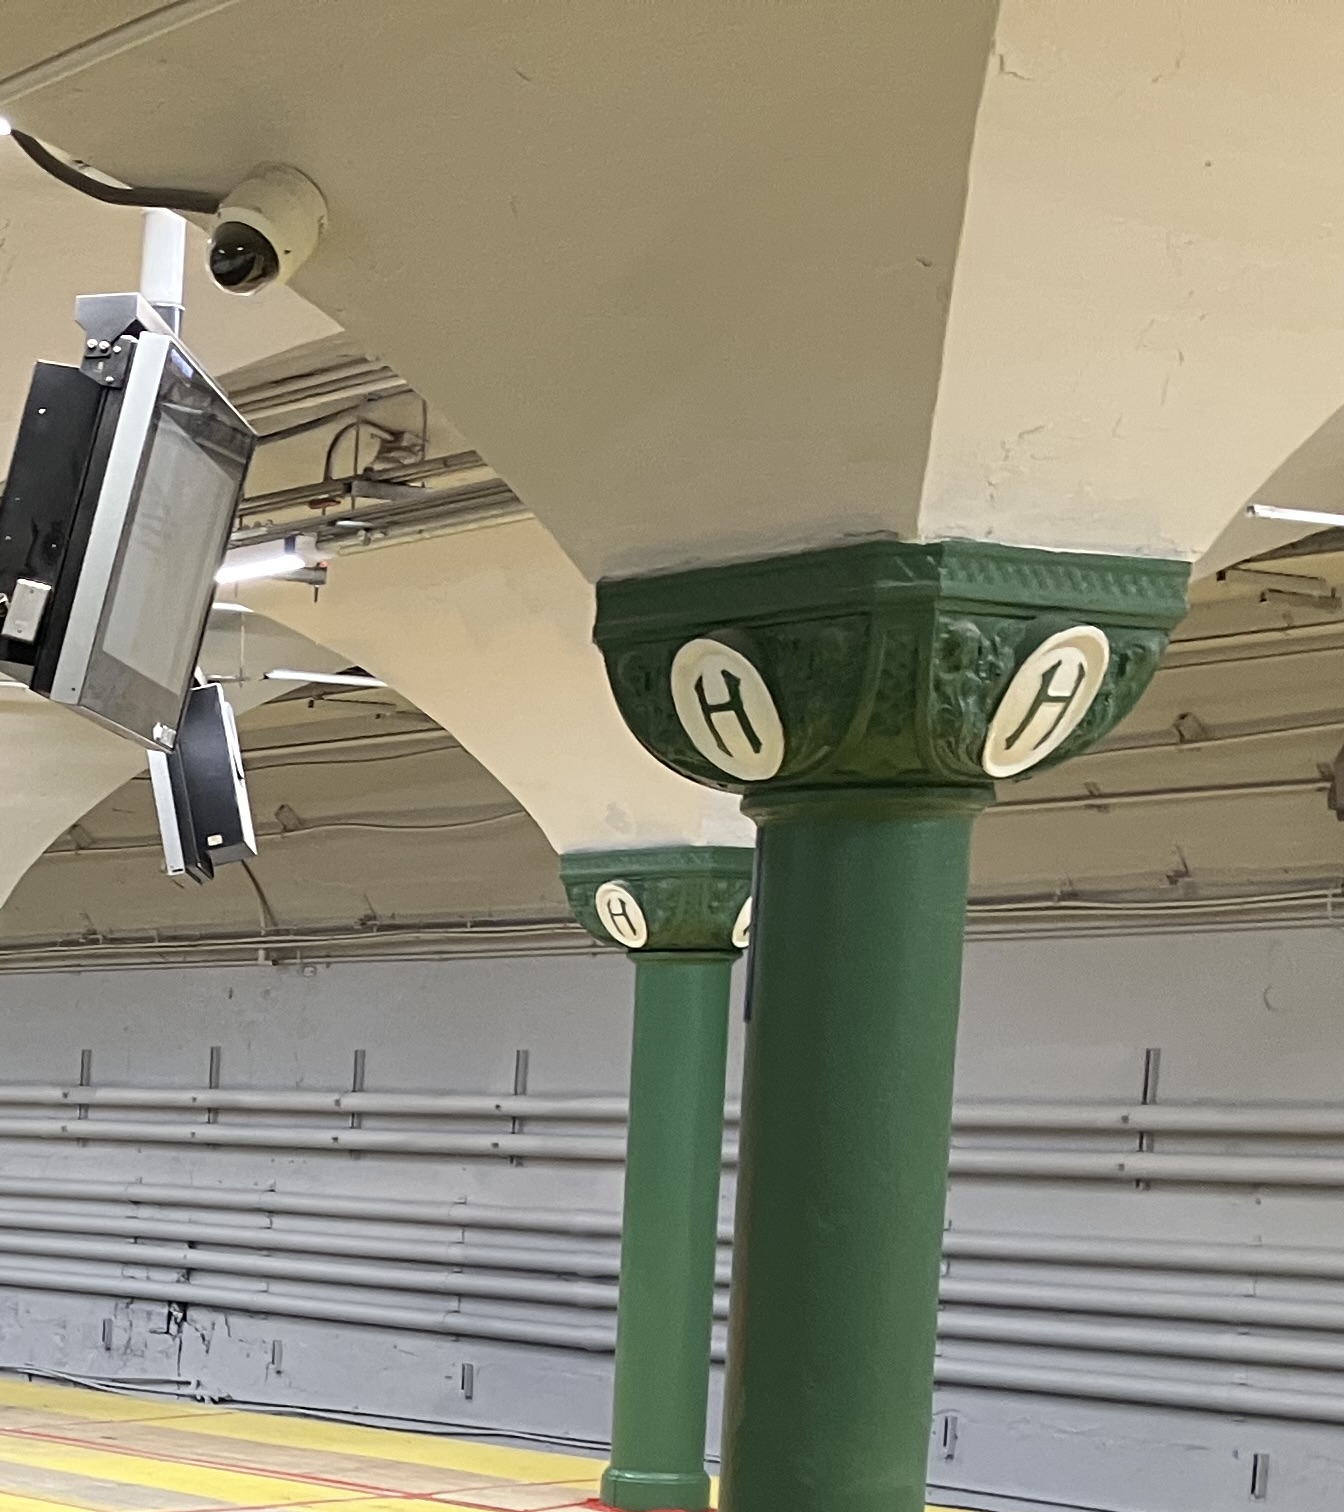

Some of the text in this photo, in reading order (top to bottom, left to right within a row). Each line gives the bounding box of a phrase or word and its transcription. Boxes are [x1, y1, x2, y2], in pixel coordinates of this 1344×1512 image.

[693, 668, 764, 758] H
[1003, 659, 1087, 752] H
[606, 897, 637, 938] H
